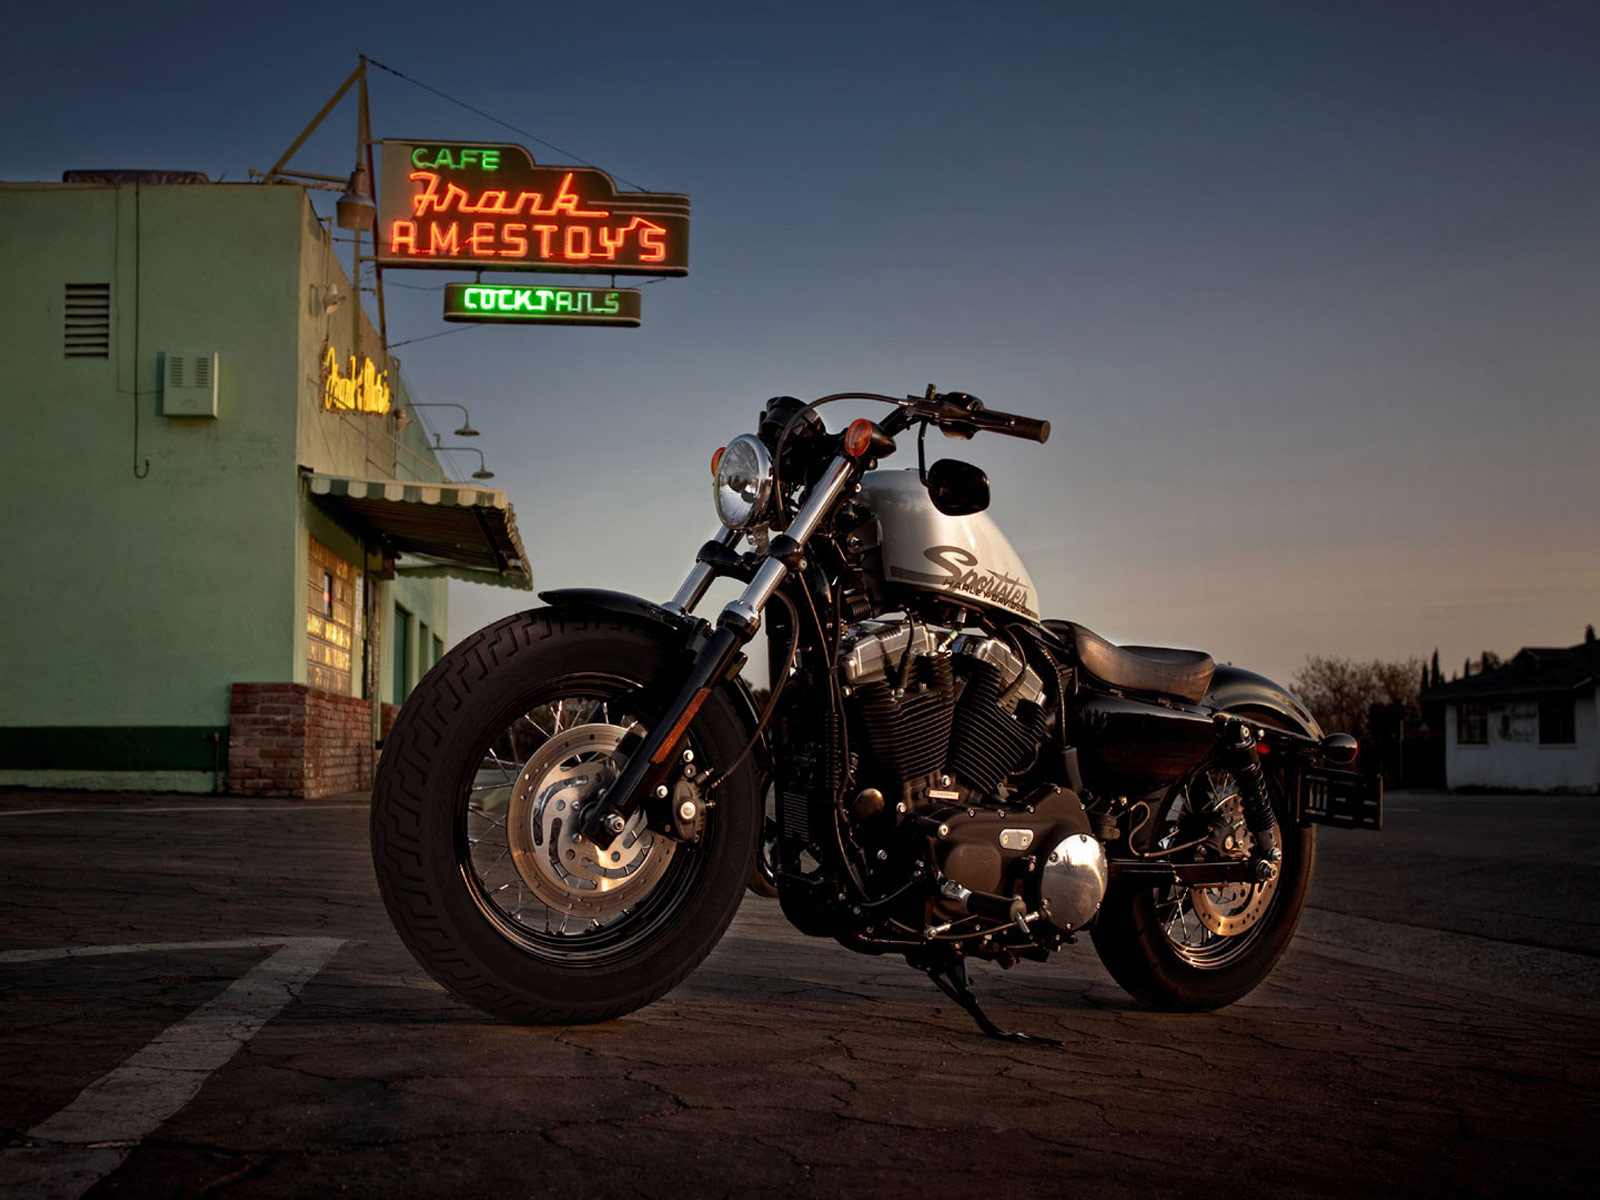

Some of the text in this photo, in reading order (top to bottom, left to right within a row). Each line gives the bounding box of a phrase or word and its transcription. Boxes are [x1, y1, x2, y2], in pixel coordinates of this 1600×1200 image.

[411, 147, 500, 170] CAFE
[409, 171, 610, 217] Frank
[390, 215, 667, 262] AMESTOY'S
[463, 287, 620, 313] COCKTAILS
